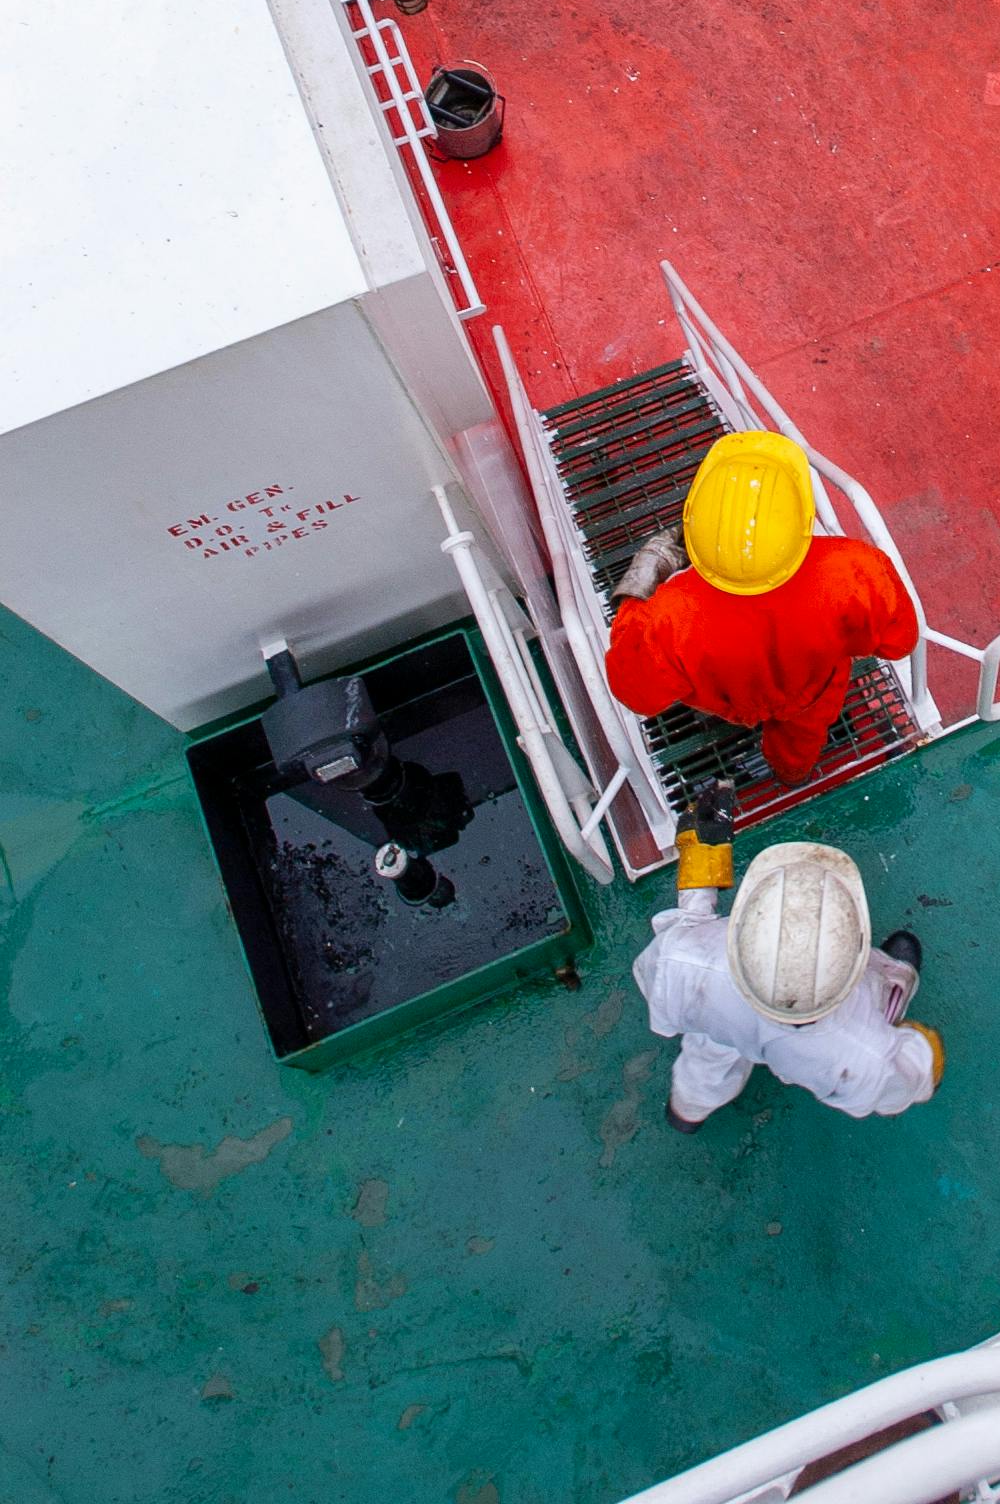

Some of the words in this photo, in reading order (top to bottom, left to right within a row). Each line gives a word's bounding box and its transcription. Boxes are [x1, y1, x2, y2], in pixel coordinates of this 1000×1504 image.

[167, 514, 219, 537] EM.
[226, 484, 294, 512] GEN.
[203, 534, 250, 559] AIR
[296, 494, 361, 522] FILL
[244, 519, 328, 558] PIPES
